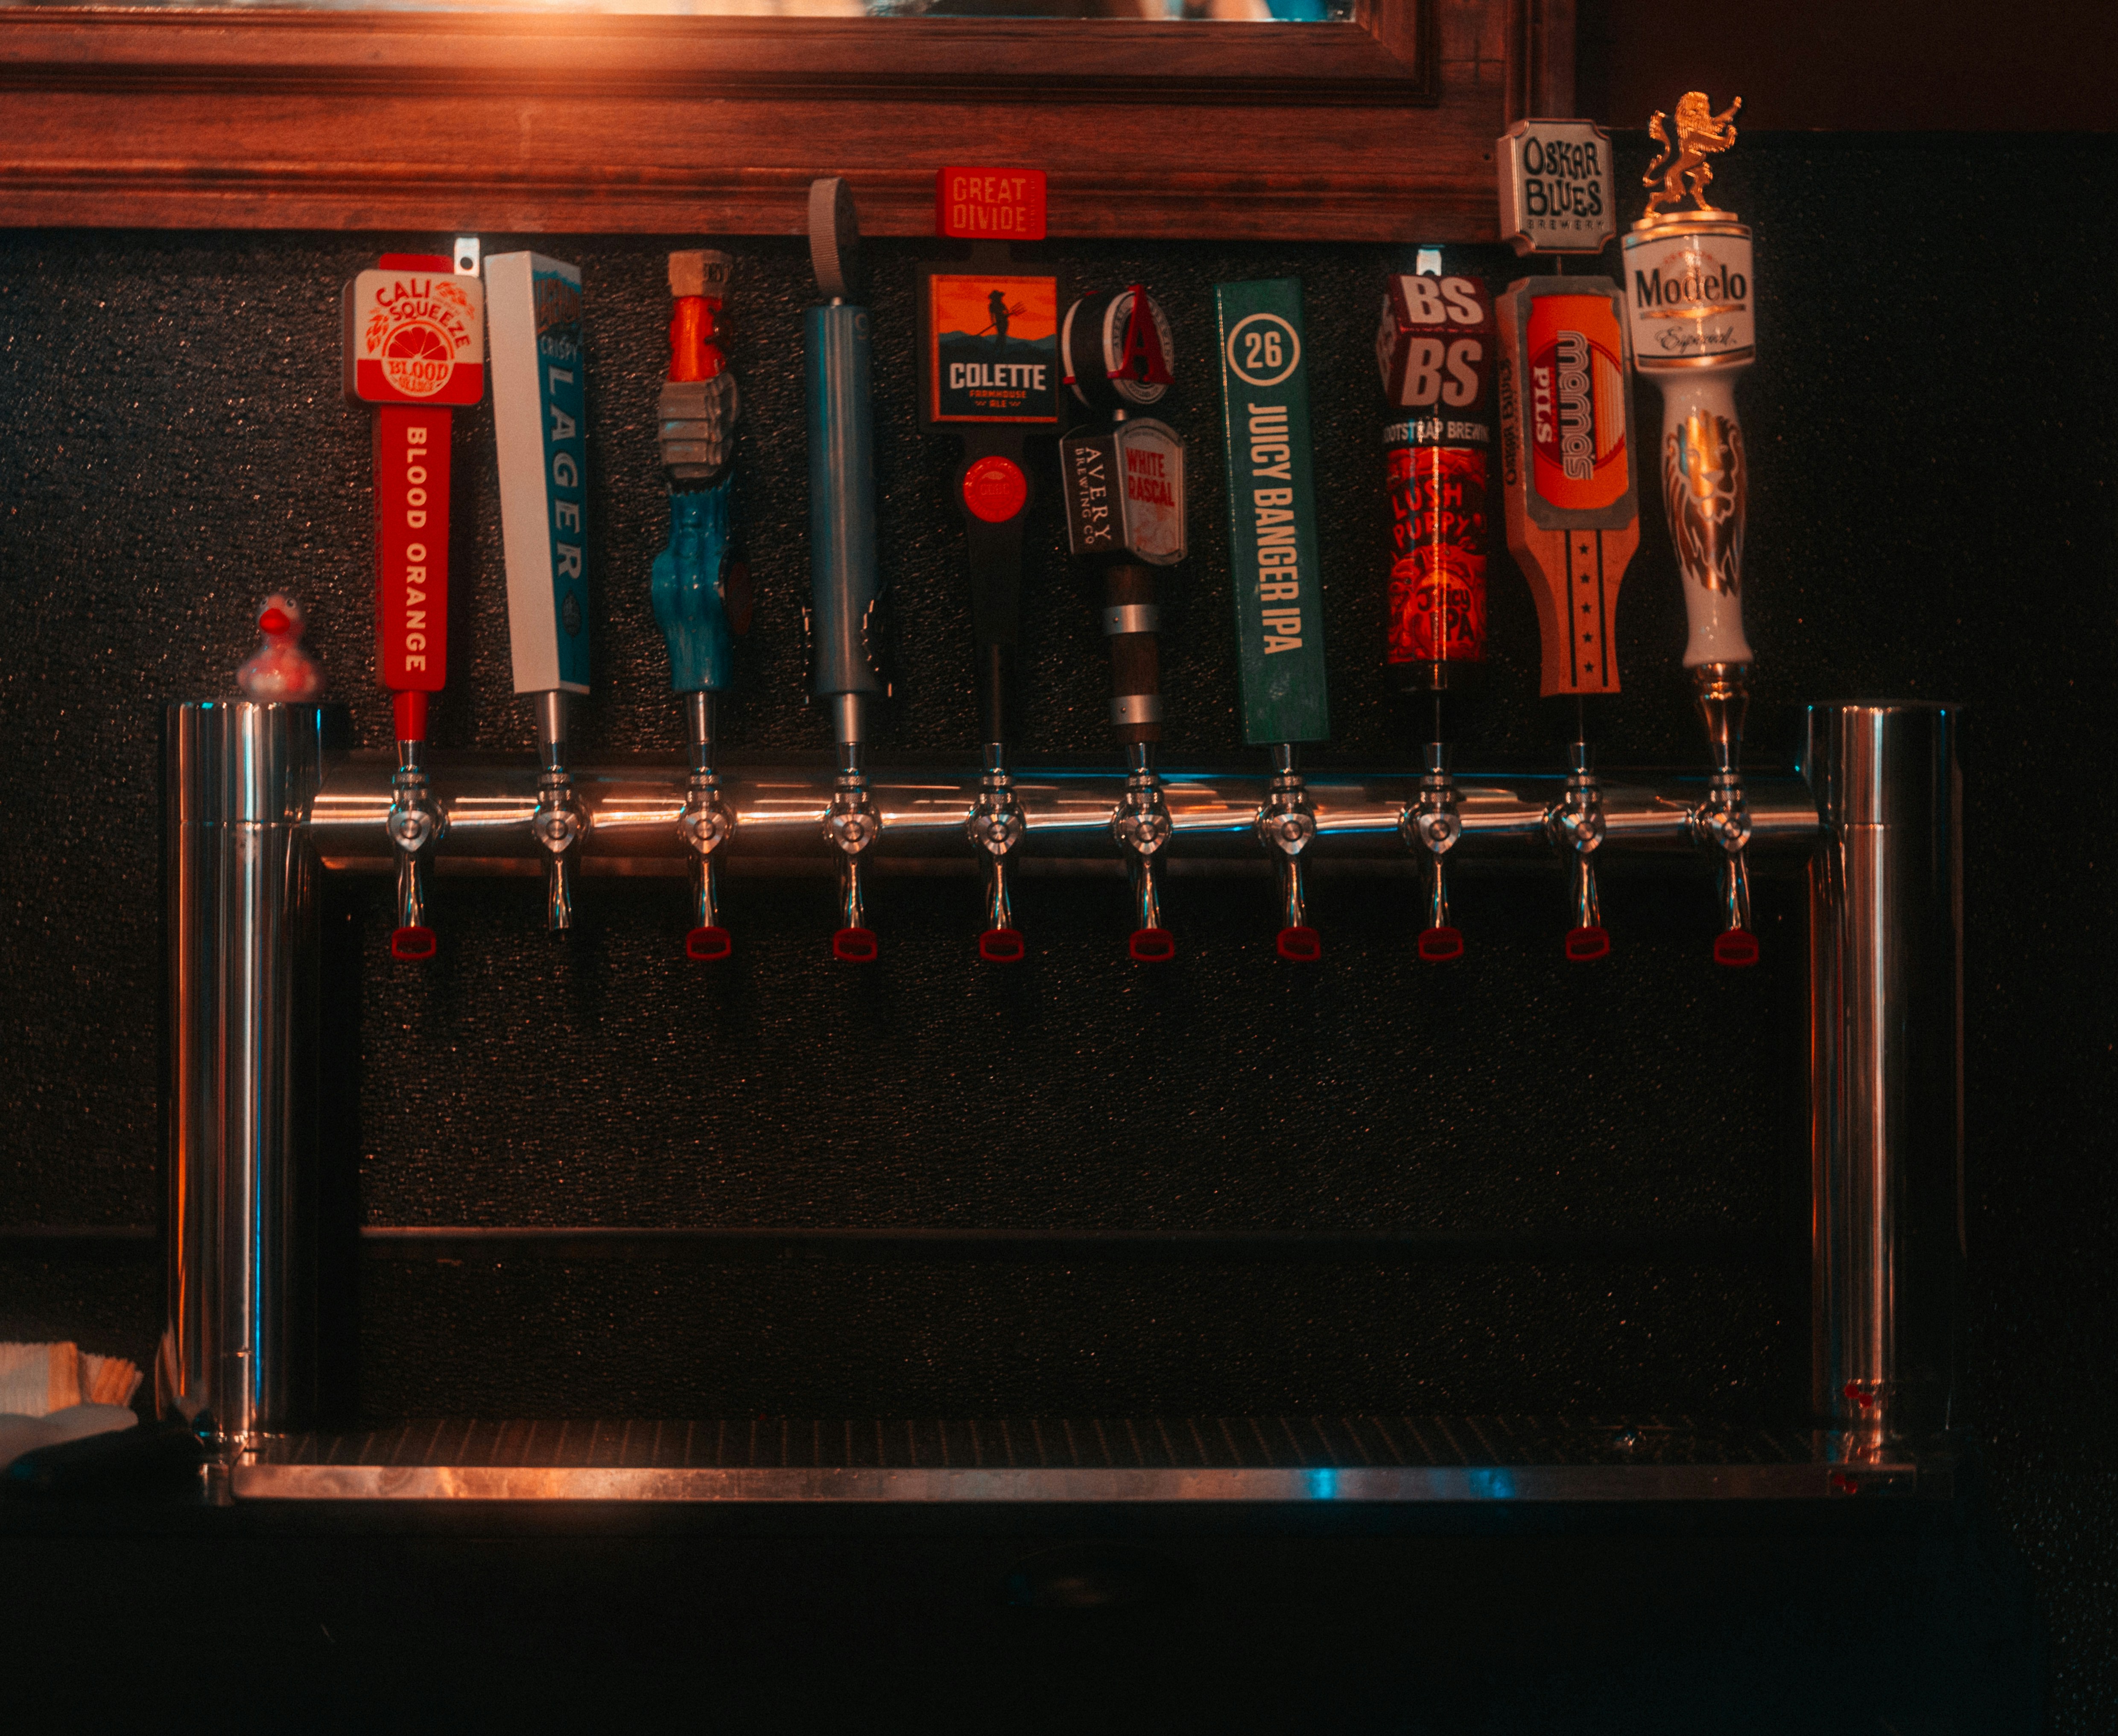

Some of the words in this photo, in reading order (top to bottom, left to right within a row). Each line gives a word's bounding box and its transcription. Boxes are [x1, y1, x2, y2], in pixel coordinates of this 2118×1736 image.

[1524, 137, 1601, 179] OSKAR
[953, 177, 1026, 204] GREAT
[1525, 179, 1603, 217] BLUES
[953, 204, 1026, 232] DIVIDE
[1528, 219, 1604, 230] BREWERY
[376, 278, 431, 307] CALI
[1400, 275, 1484, 324] BS
[1635, 263, 1747, 308] Modelo
[390, 301, 471, 349] SQUEEZE
[1245, 331, 1283, 368] 26
[389, 360, 449, 381] BLOOD
[950, 363, 1046, 391] COLETTE
[1400, 337, 1483, 407] BS
[969, 390, 1027, 398] FARMHOUSE
[989, 400, 1007, 408] ALE
[1533, 366, 1553, 443] PILS
[1247, 403, 1292, 480] JUICY
[406, 427, 427, 529] BLOOD
[548, 365, 582, 580] LAGER
[1125, 447, 1166, 479] WHITE
[1074, 448, 1092, 519] BREWING
[1086, 447, 1112, 541] AVERY
[1128, 475, 1175, 507] RASCAL
[1392, 480, 1463, 520] LUSH
[1253, 488, 1300, 602] BANGER
[1392, 512, 1470, 549] PUPPY
[406, 542, 427, 672] ORANGE
[1430, 608, 1474, 641] IPA
[1262, 608, 1303, 655] IPA
